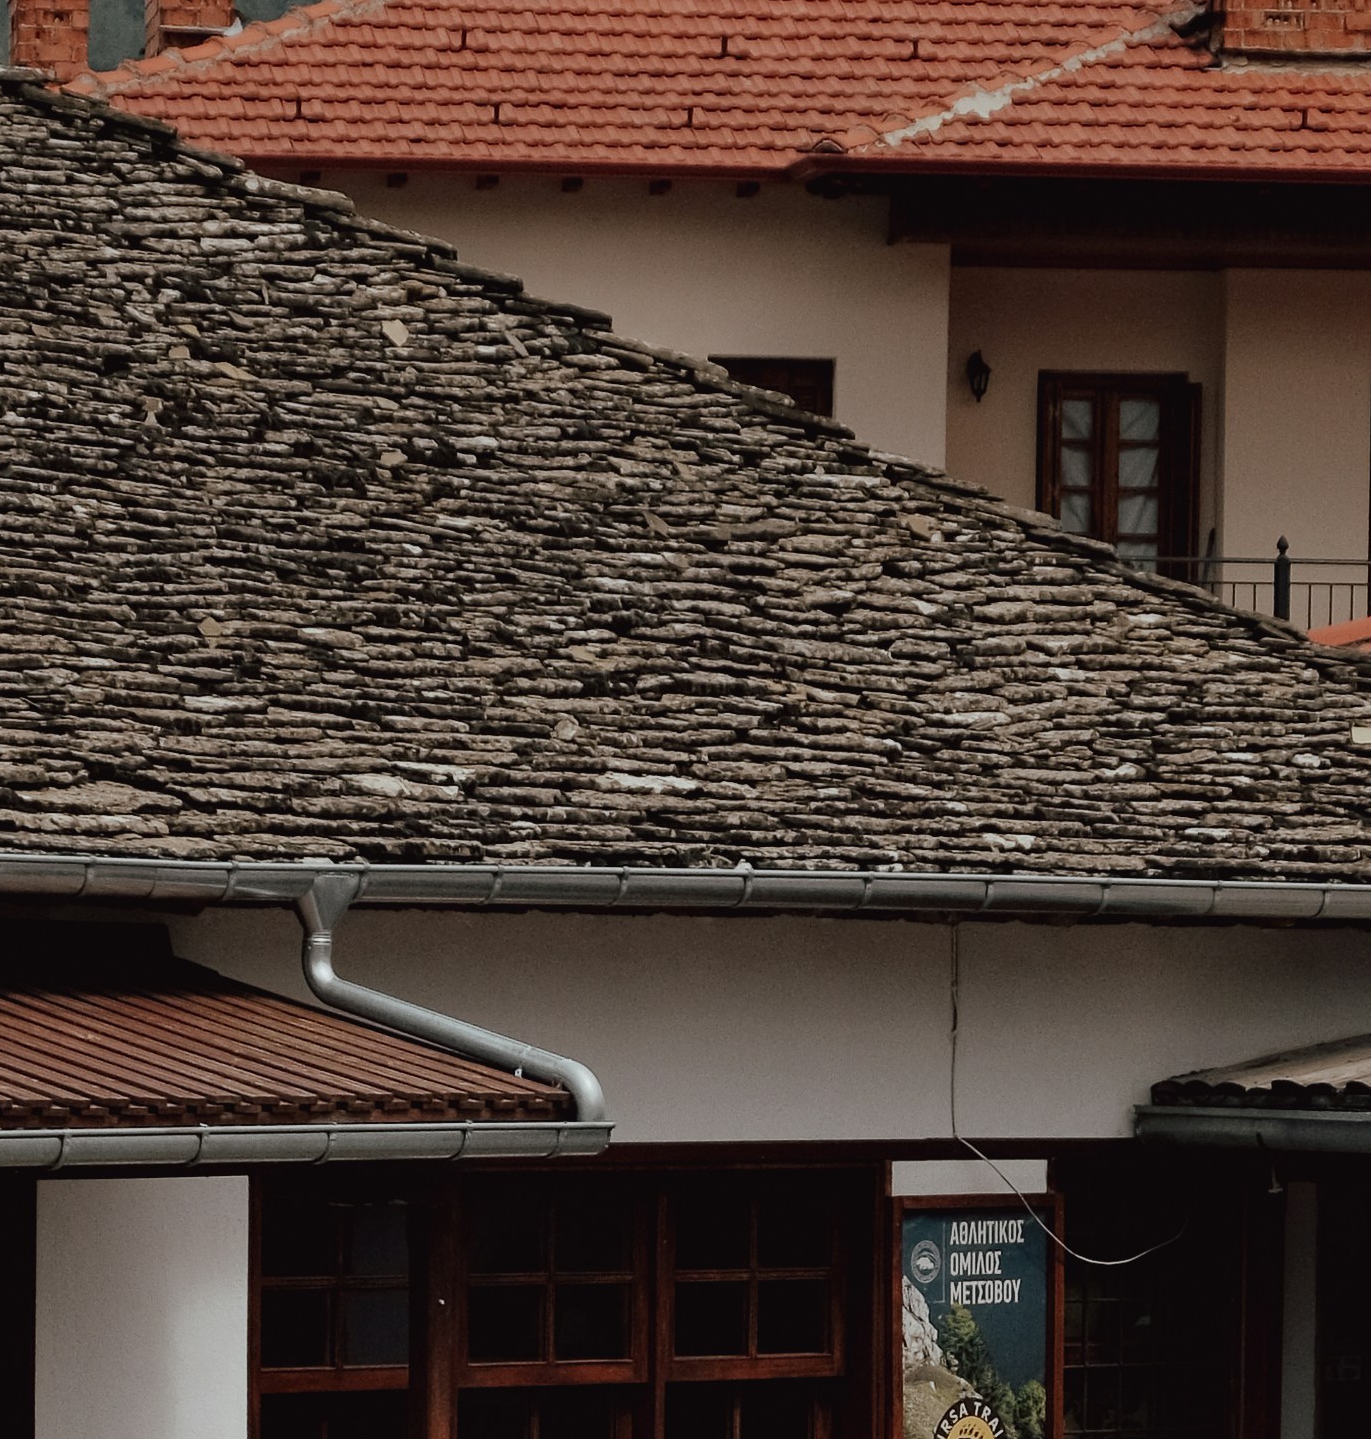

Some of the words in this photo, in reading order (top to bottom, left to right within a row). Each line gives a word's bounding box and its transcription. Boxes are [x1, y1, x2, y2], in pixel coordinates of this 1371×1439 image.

[949, 1219, 1025, 1245] ΑΘΛΗΤΙΚΟΣ
[949, 1250, 1002, 1276] ΟΜΙΛΟΣ
[949, 1278, 1021, 1305] ΜΕΤΣΟΒΟΥ
